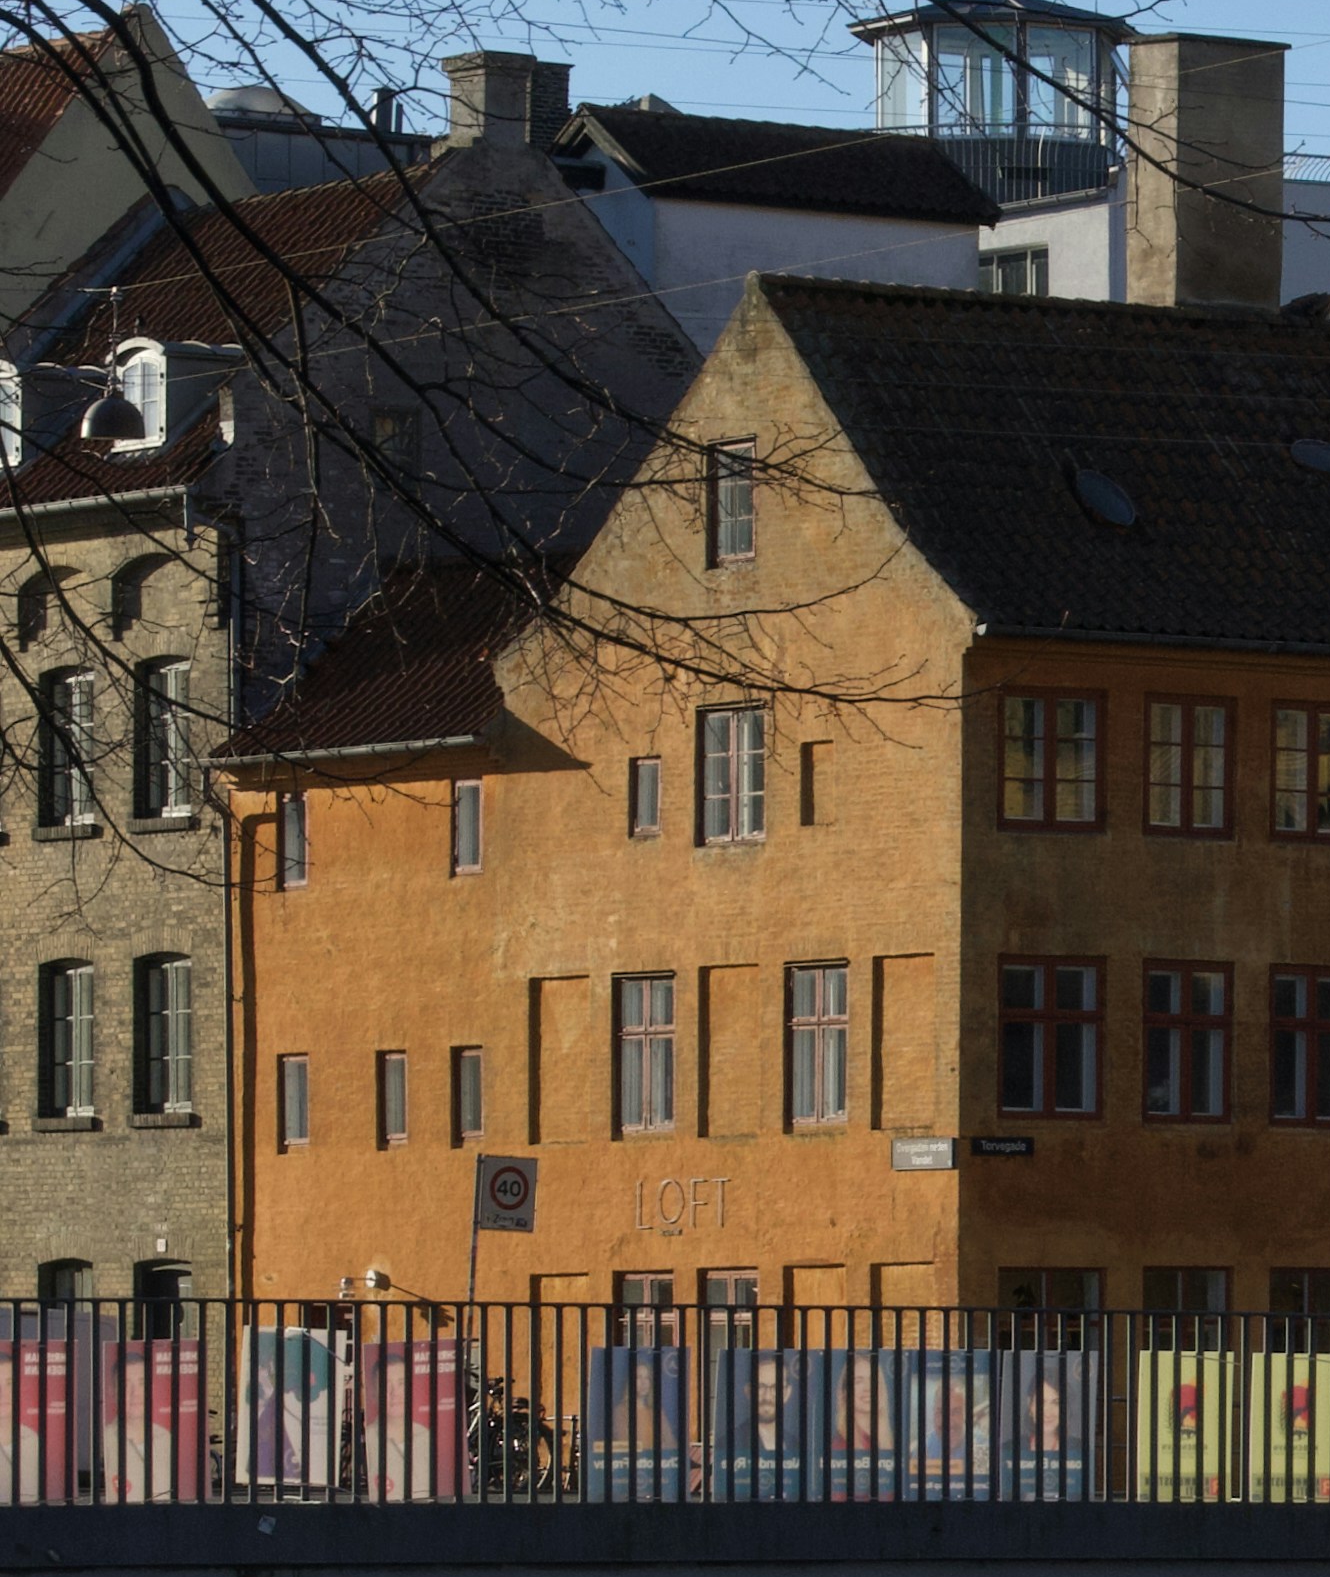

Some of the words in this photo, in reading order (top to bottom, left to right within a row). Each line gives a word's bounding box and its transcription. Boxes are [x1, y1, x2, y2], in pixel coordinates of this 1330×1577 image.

[980, 1140, 1027, 1153] Torvegade
[497, 1180, 521, 1197] 40
[636, 1178, 732, 1229] LOFT
